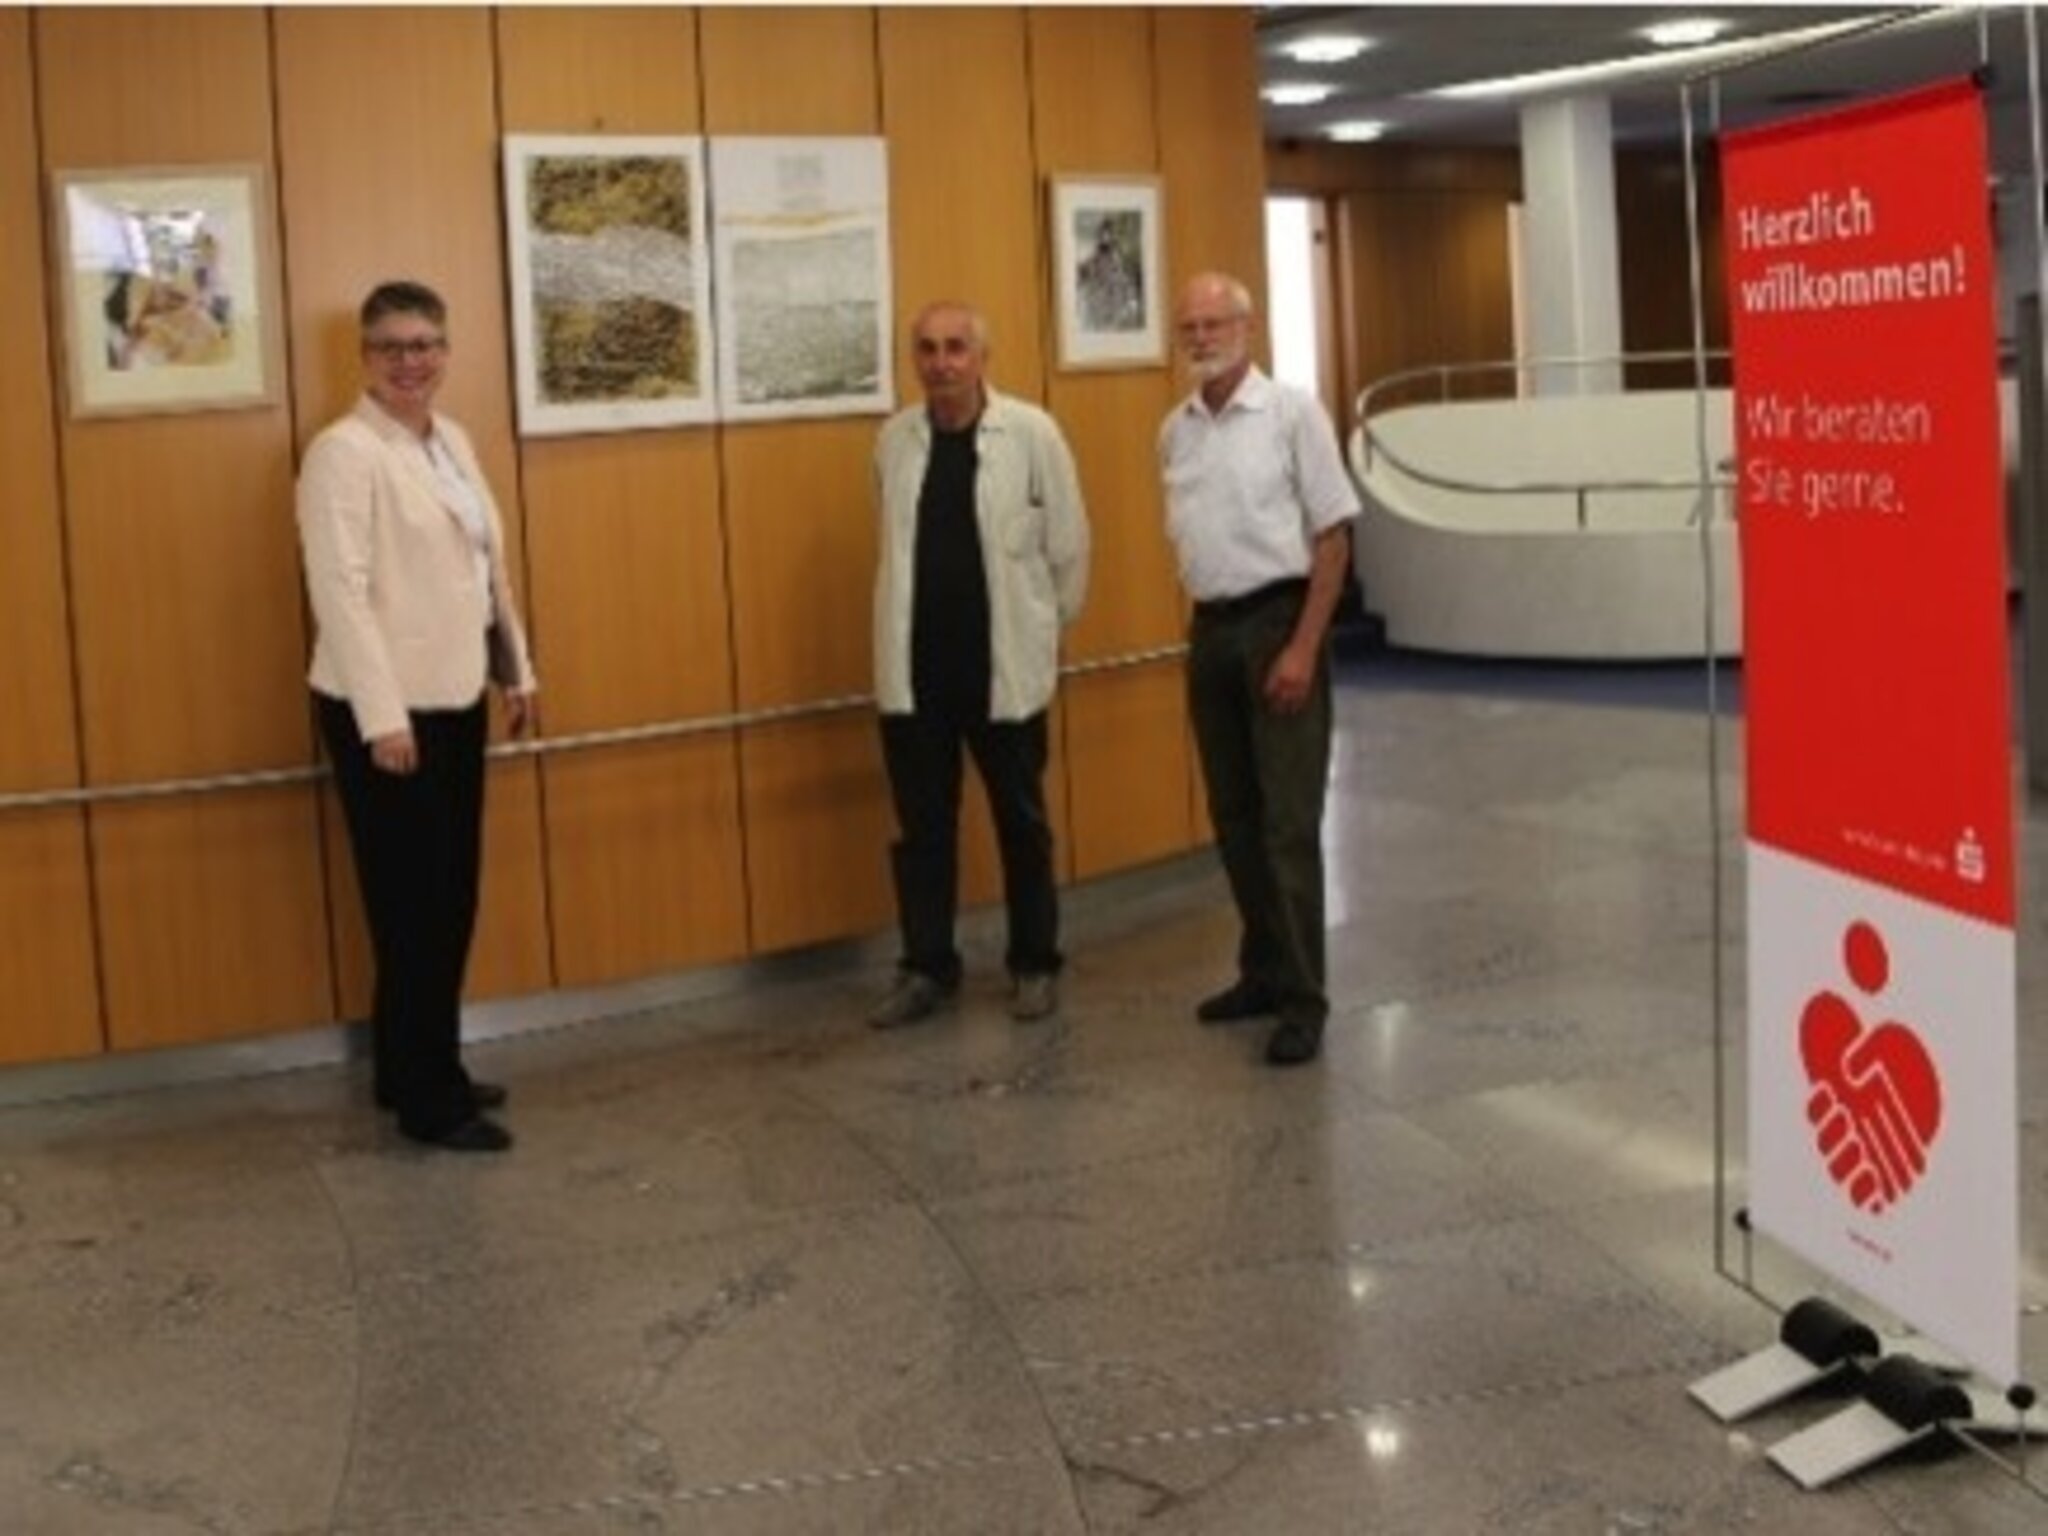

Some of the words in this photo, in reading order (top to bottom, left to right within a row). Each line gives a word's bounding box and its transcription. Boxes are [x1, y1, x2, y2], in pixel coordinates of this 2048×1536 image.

[1739, 186, 1874, 250] Herzlich
[1742, 244, 1966, 312] willkommen!
[1746, 395, 1797, 439] Wir
[1804, 394, 1931, 442] beraten
[1746, 458, 1795, 503] Sie
[1802, 468, 1905, 518] gerne.
